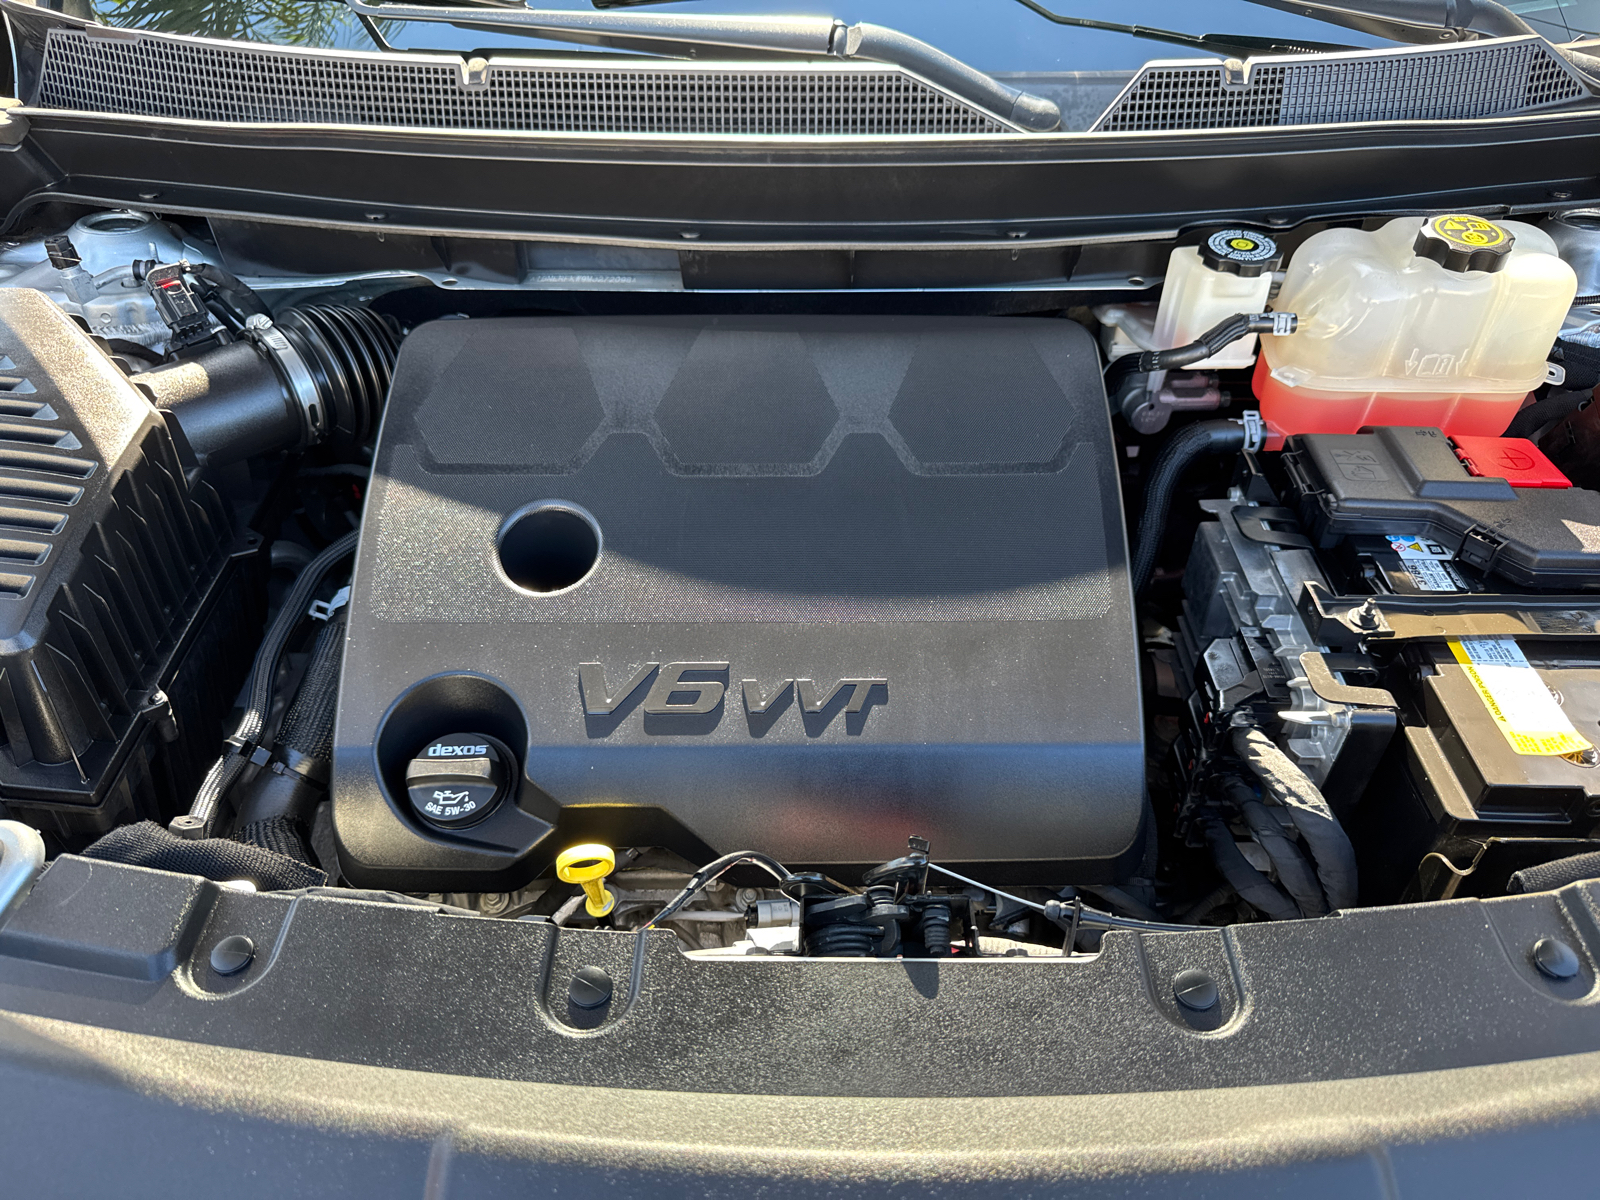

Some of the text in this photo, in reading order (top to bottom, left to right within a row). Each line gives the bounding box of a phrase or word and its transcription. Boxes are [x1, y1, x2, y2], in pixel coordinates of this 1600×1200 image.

[579, 661, 888, 716] V6 VVT
[1466, 665, 1502, 717] DANGER POISON
[428, 743, 489, 756] dexos
[425, 800, 476, 816] SAE 5W-30
